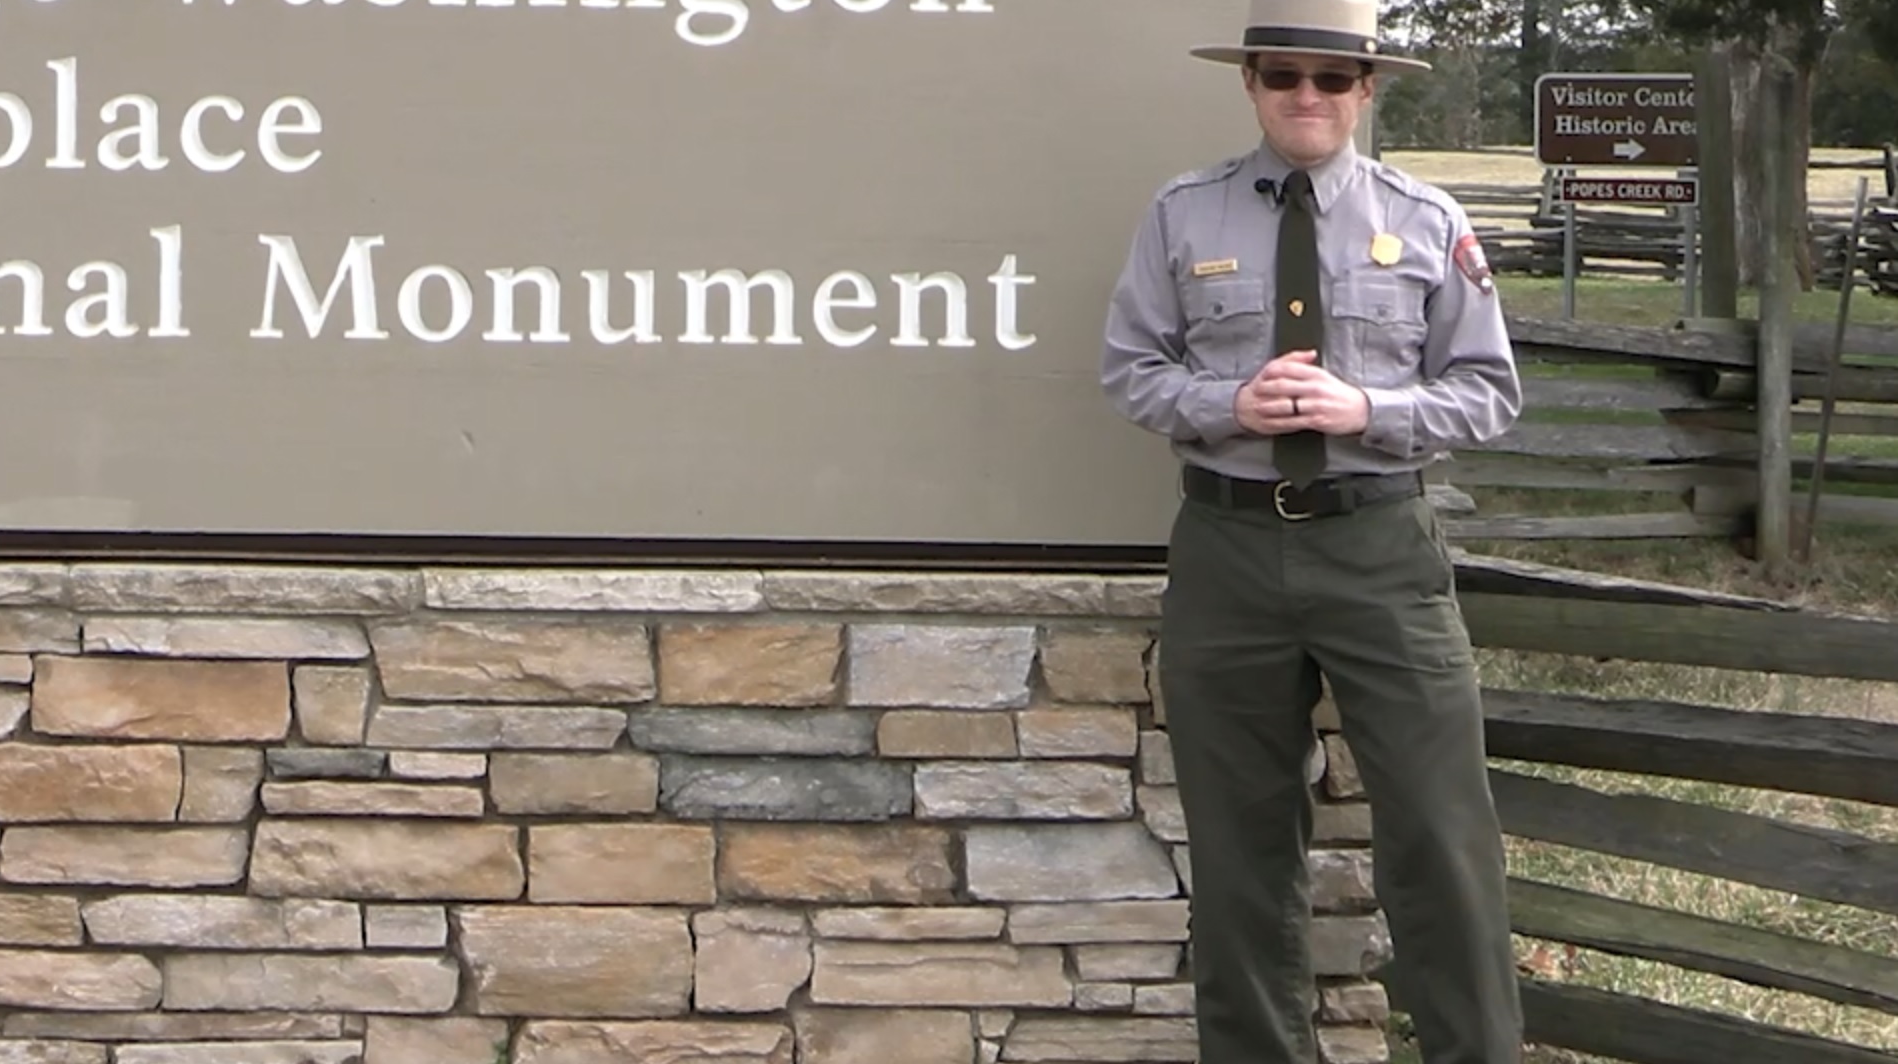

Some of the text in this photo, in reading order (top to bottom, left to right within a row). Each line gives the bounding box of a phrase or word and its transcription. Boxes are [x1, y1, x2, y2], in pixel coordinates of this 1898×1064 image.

[1551, 82, 1628, 107] Visitor
[1555, 115, 1646, 135] Historic
[1570, 182, 1615, 198] POPES
[1617, 183, 1661, 199] CREEK
[249, 233, 1037, 350] Monument
